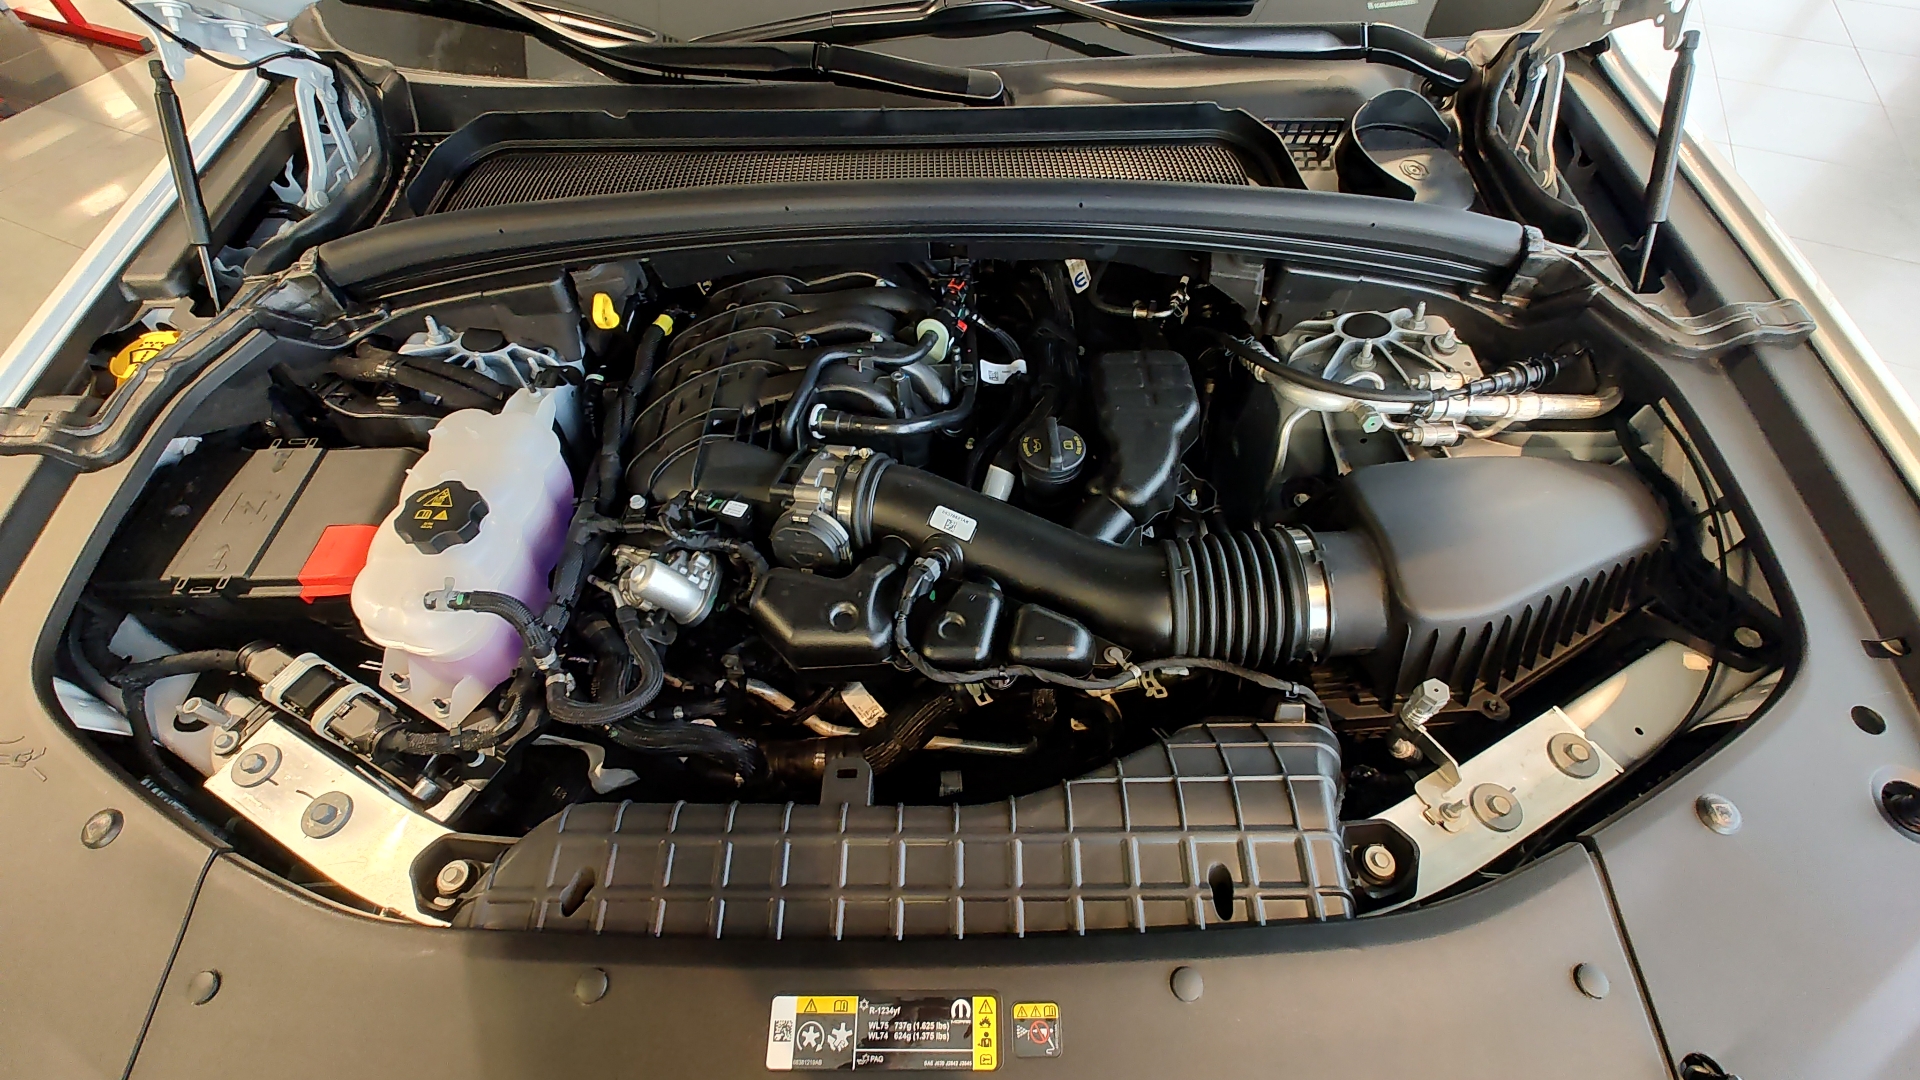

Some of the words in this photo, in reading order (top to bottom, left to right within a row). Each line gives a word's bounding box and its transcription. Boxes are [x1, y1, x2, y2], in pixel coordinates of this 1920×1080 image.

[869, 1006, 901, 1017] R-1234yf
[868, 1021, 889, 1031] WL75
[894, 1021, 912, 1032] 737g
[913, 1021, 935, 1032] (1.625
[935, 1021, 950, 1032] lbs)
[867, 1031, 889, 1041] WL74
[893, 1031, 912, 1042] 624g
[912, 1031, 935, 1042] (1.375
[935, 1031, 950, 1042] lbs)
[870, 1055, 884, 1063] PAG
